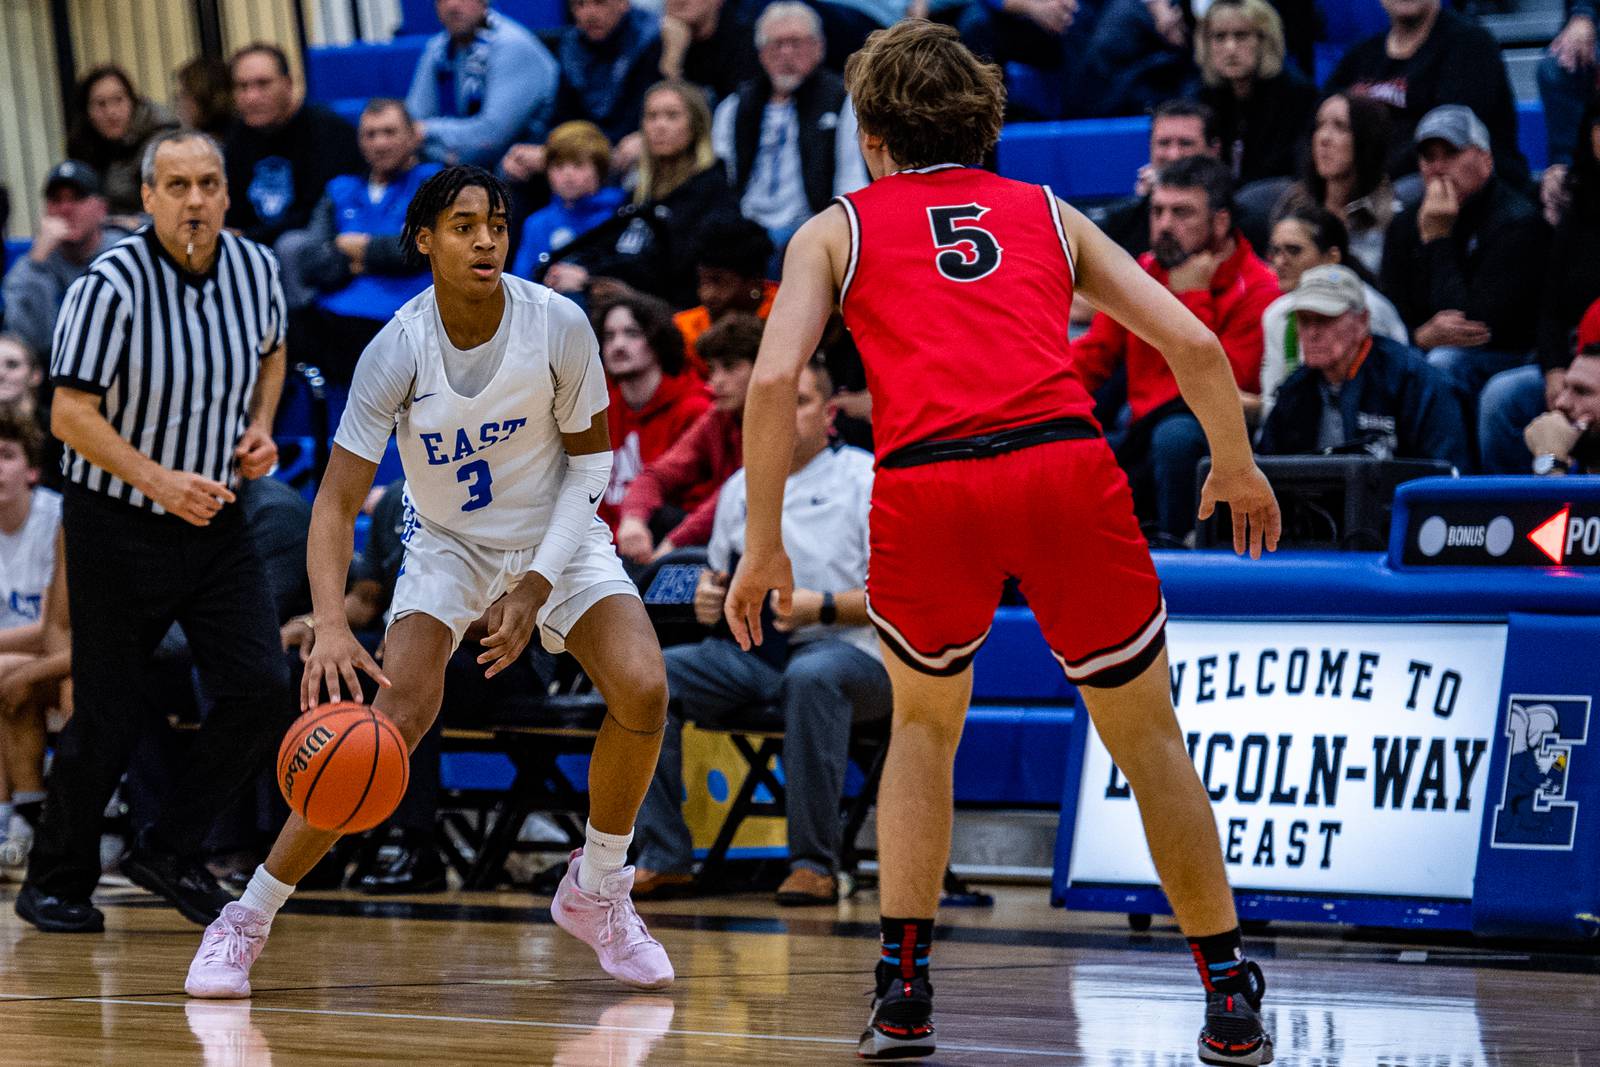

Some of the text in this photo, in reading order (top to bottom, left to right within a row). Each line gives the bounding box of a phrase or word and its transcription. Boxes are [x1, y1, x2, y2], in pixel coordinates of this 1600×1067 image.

[926, 202, 1003, 282] 5
[420, 417, 527, 465] EAST
[456, 459, 493, 512] 3
[1448, 526, 1485, 546] BONUS
[1406, 660, 1462, 719] TO
[1104, 732, 1489, 812] LCOLN-WAY
[1226, 818, 1343, 869] EAST
